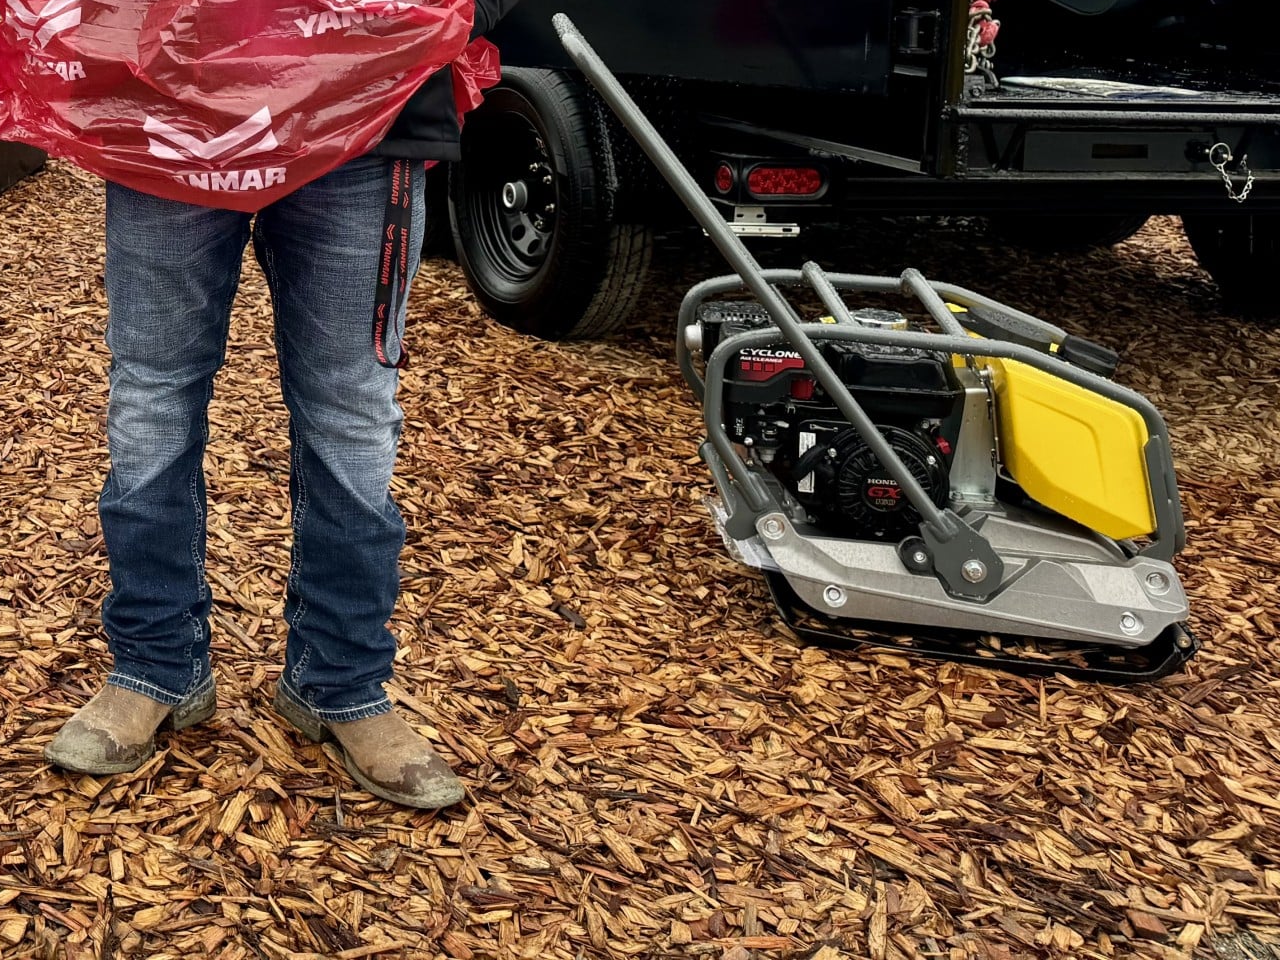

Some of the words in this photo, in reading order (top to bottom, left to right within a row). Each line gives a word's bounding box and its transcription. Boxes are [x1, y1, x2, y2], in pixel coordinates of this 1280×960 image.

[172, 167, 287, 191] NMAR
[391, 159, 402, 205] YANMAR
[381, 242, 392, 285] YANMAR
[375, 320, 386, 364] YANMAR
[868, 487, 901, 498] GX
